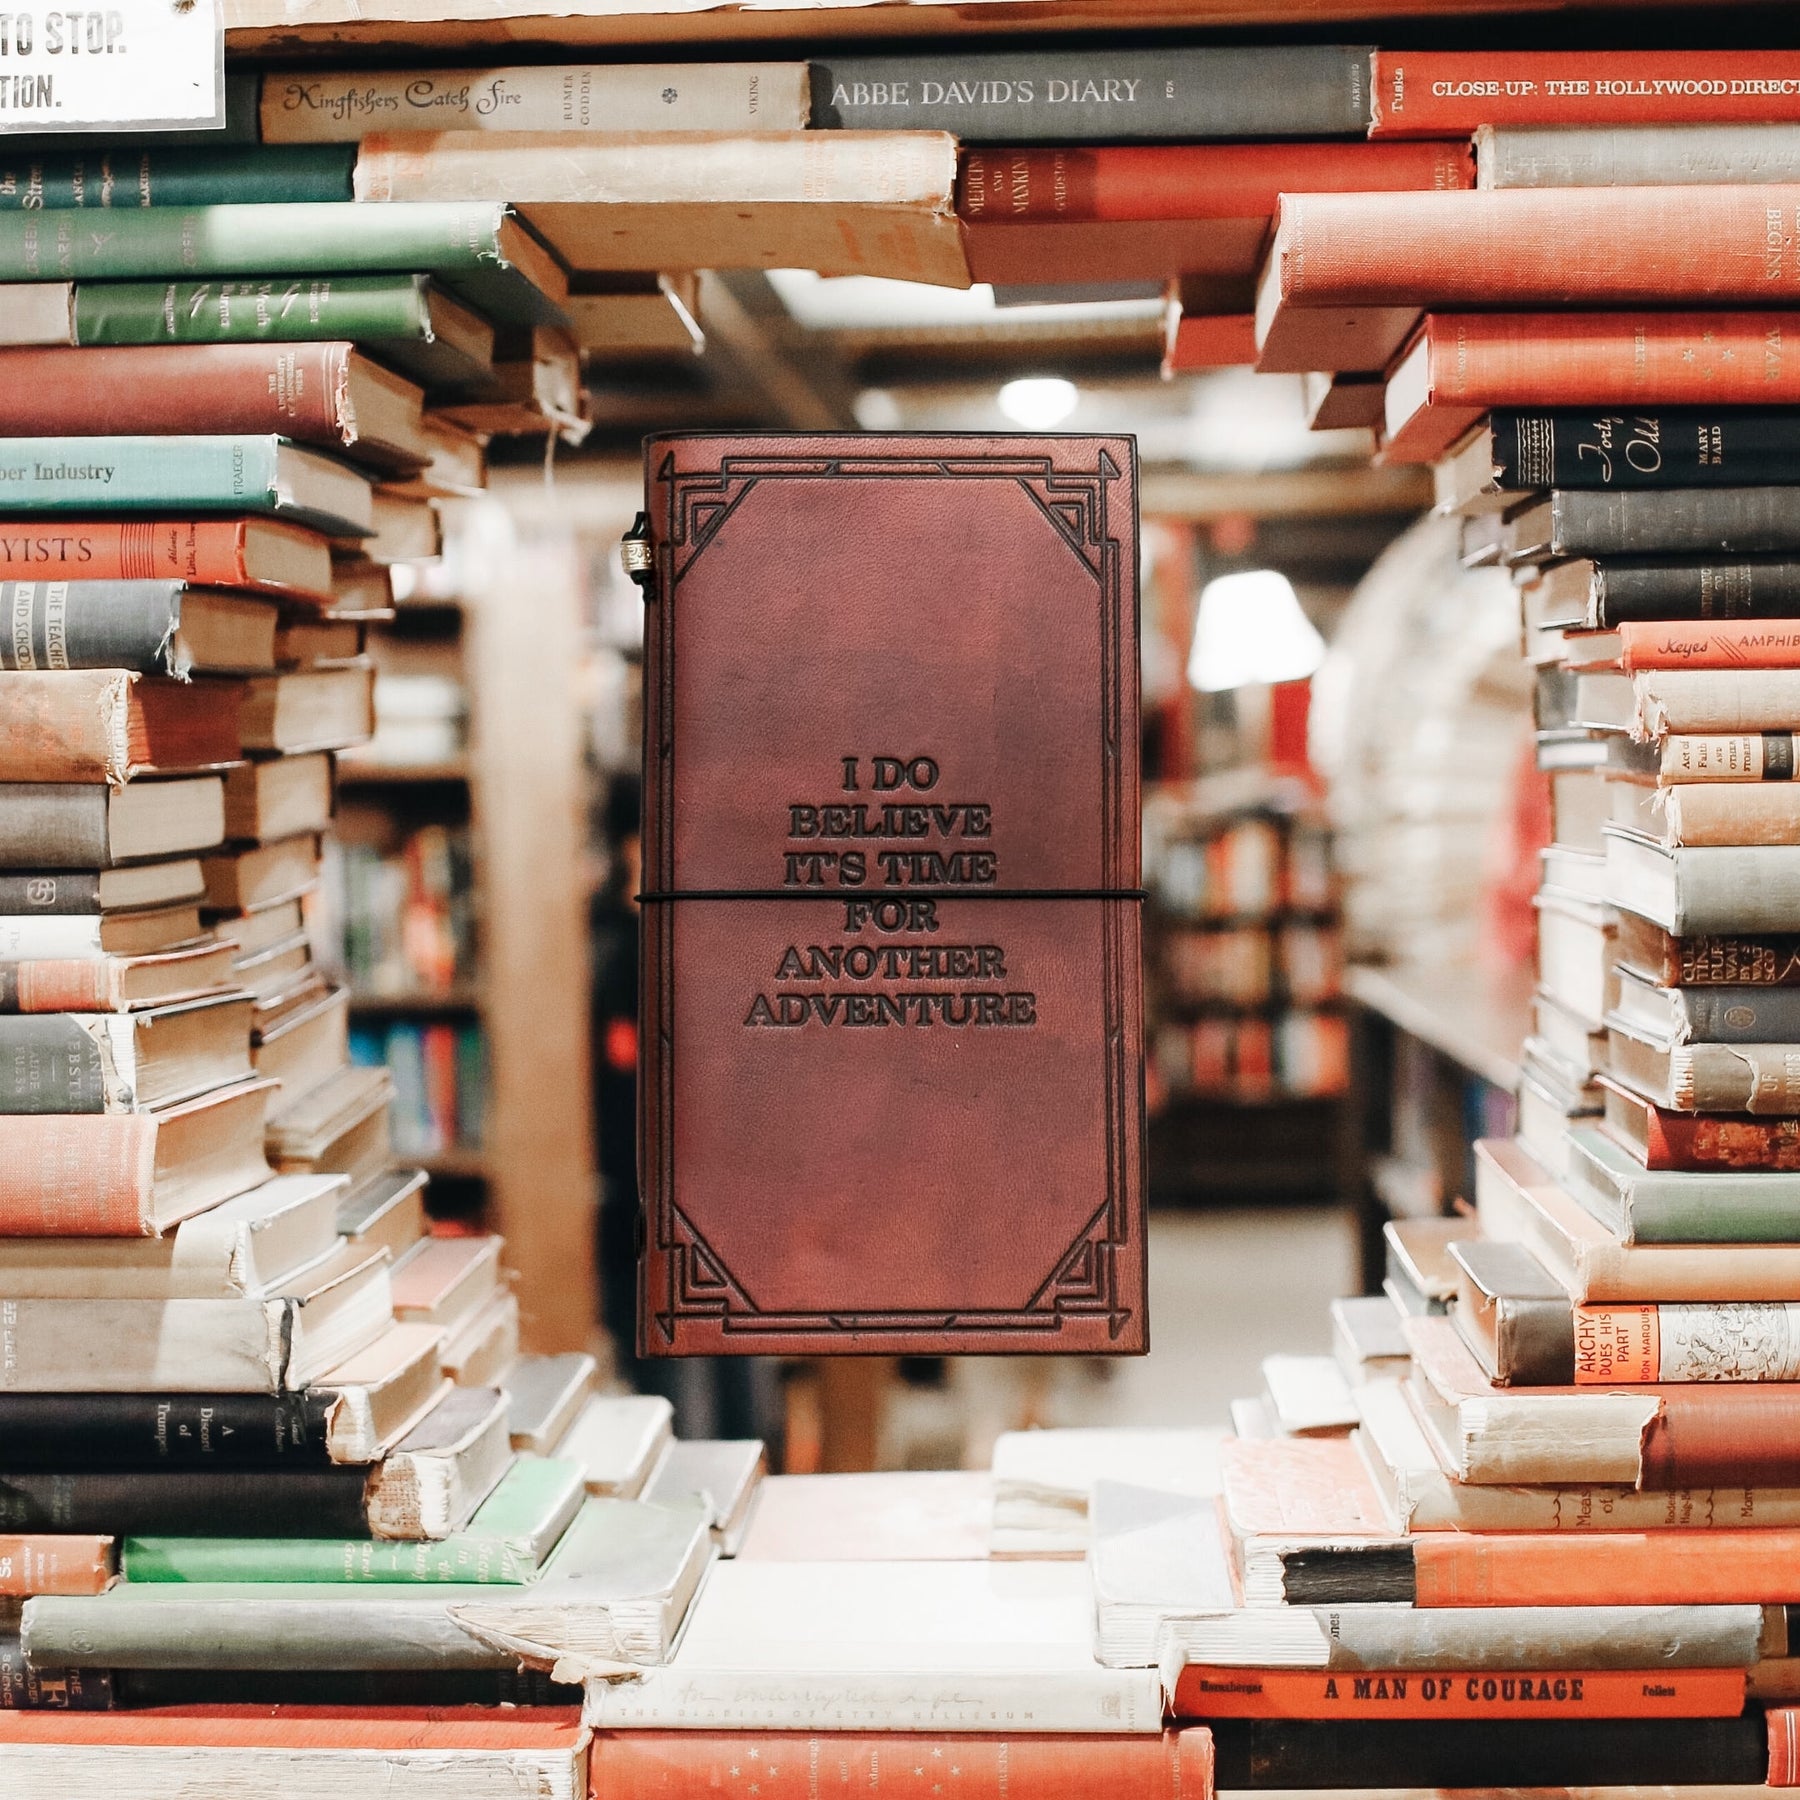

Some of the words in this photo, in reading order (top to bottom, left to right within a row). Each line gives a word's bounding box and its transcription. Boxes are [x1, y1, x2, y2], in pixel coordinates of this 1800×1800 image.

[45, 10, 127, 55] STOP.
[283, 82, 398, 120] Kingfishers
[404, 80, 469, 113] Catch
[475, 79, 522, 115] Fire
[564, 74, 573, 121] RUMER
[581, 70, 591, 126] GODDEN
[748, 75, 759, 115] VIKING
[830, 82, 910, 106] ABBE
[920, 80, 1034, 104] DAVID'S
[1046, 78, 1142, 103] DIARY
[1432, 80, 1538, 97] CLOSE-UP:
[1545, 79, 1590, 97] THE
[1594, 78, 1728, 96] HOLLYWOOD
[1766, 208, 1781, 280] BEGINS
[1698, 425, 1709, 465] MARY
[1711, 425, 1722, 465] BARD
[33, 462, 115, 483] Industry
[233, 444, 243, 495] PRAEGER
[1, 537, 92, 562] YISTS
[16, 590, 30, 617] AND
[49, 588, 64, 610] THE
[1657, 638, 1708, 659] Keyes
[1682, 751, 1690, 769] Act
[1698, 743, 1708, 768] Faith
[842, 757, 858, 791] I
[872, 757, 939, 791] DO
[788, 804, 992, 839] BELIEVE
[783, 851, 867, 887] IT'S
[878, 851, 998, 887] TIME
[843, 900, 940, 933] FOR
[774, 945, 1008, 980] ANOTHER
[743, 992, 1038, 1028] ADVENTURE
[1762, 1071, 1778, 1092] OF
[1599, 1313, 1612, 1334] HIS
[1641, 1307, 1651, 1355] MARQUIS
[1578, 1315, 1596, 1373] ARCHY
[1616, 1326, 1629, 1362] PART
[1640, 1360, 1651, 1380] DON
[178, 1424, 192, 1437] of
[200, 1408, 214, 1452] Discord
[222, 1426, 235, 1437] A
[1600, 1498, 1613, 1514] of
[2, 1653, 14, 1707] SCIENCE
[1325, 1679, 1339, 1699] A
[1354, 1678, 1407, 1699] MAN
[1421, 1678, 1452, 1699] OF
[1466, 1678, 1584, 1700] COURAGE
[869, 1749, 879, 1791] Adams
